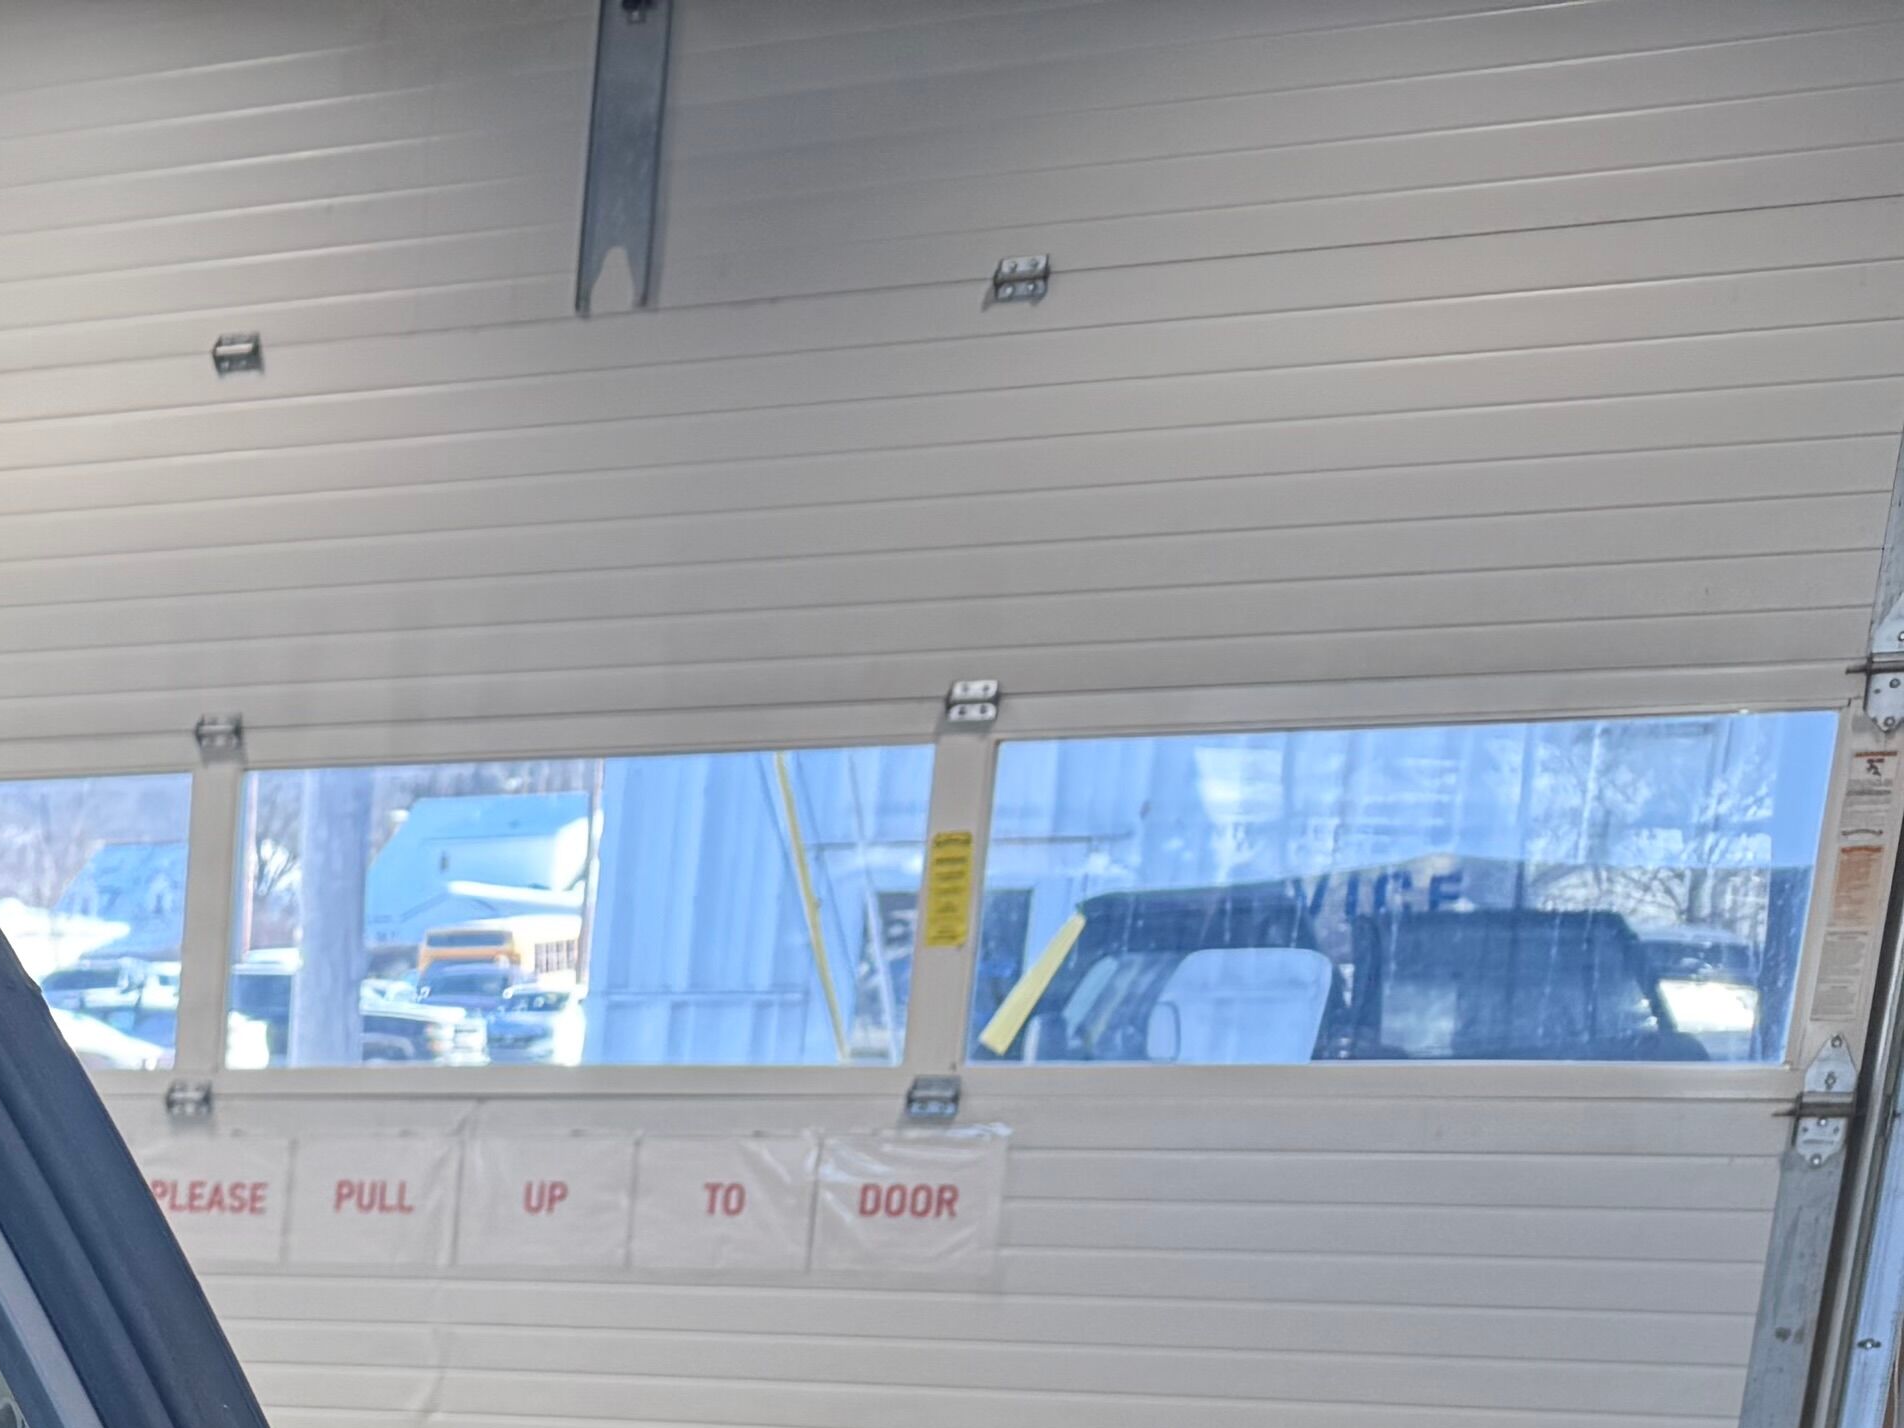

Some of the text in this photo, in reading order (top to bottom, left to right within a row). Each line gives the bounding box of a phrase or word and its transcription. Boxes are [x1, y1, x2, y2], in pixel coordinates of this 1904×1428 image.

[151, 1180, 960, 1218] PLEASE PULL UP TO DOOR
